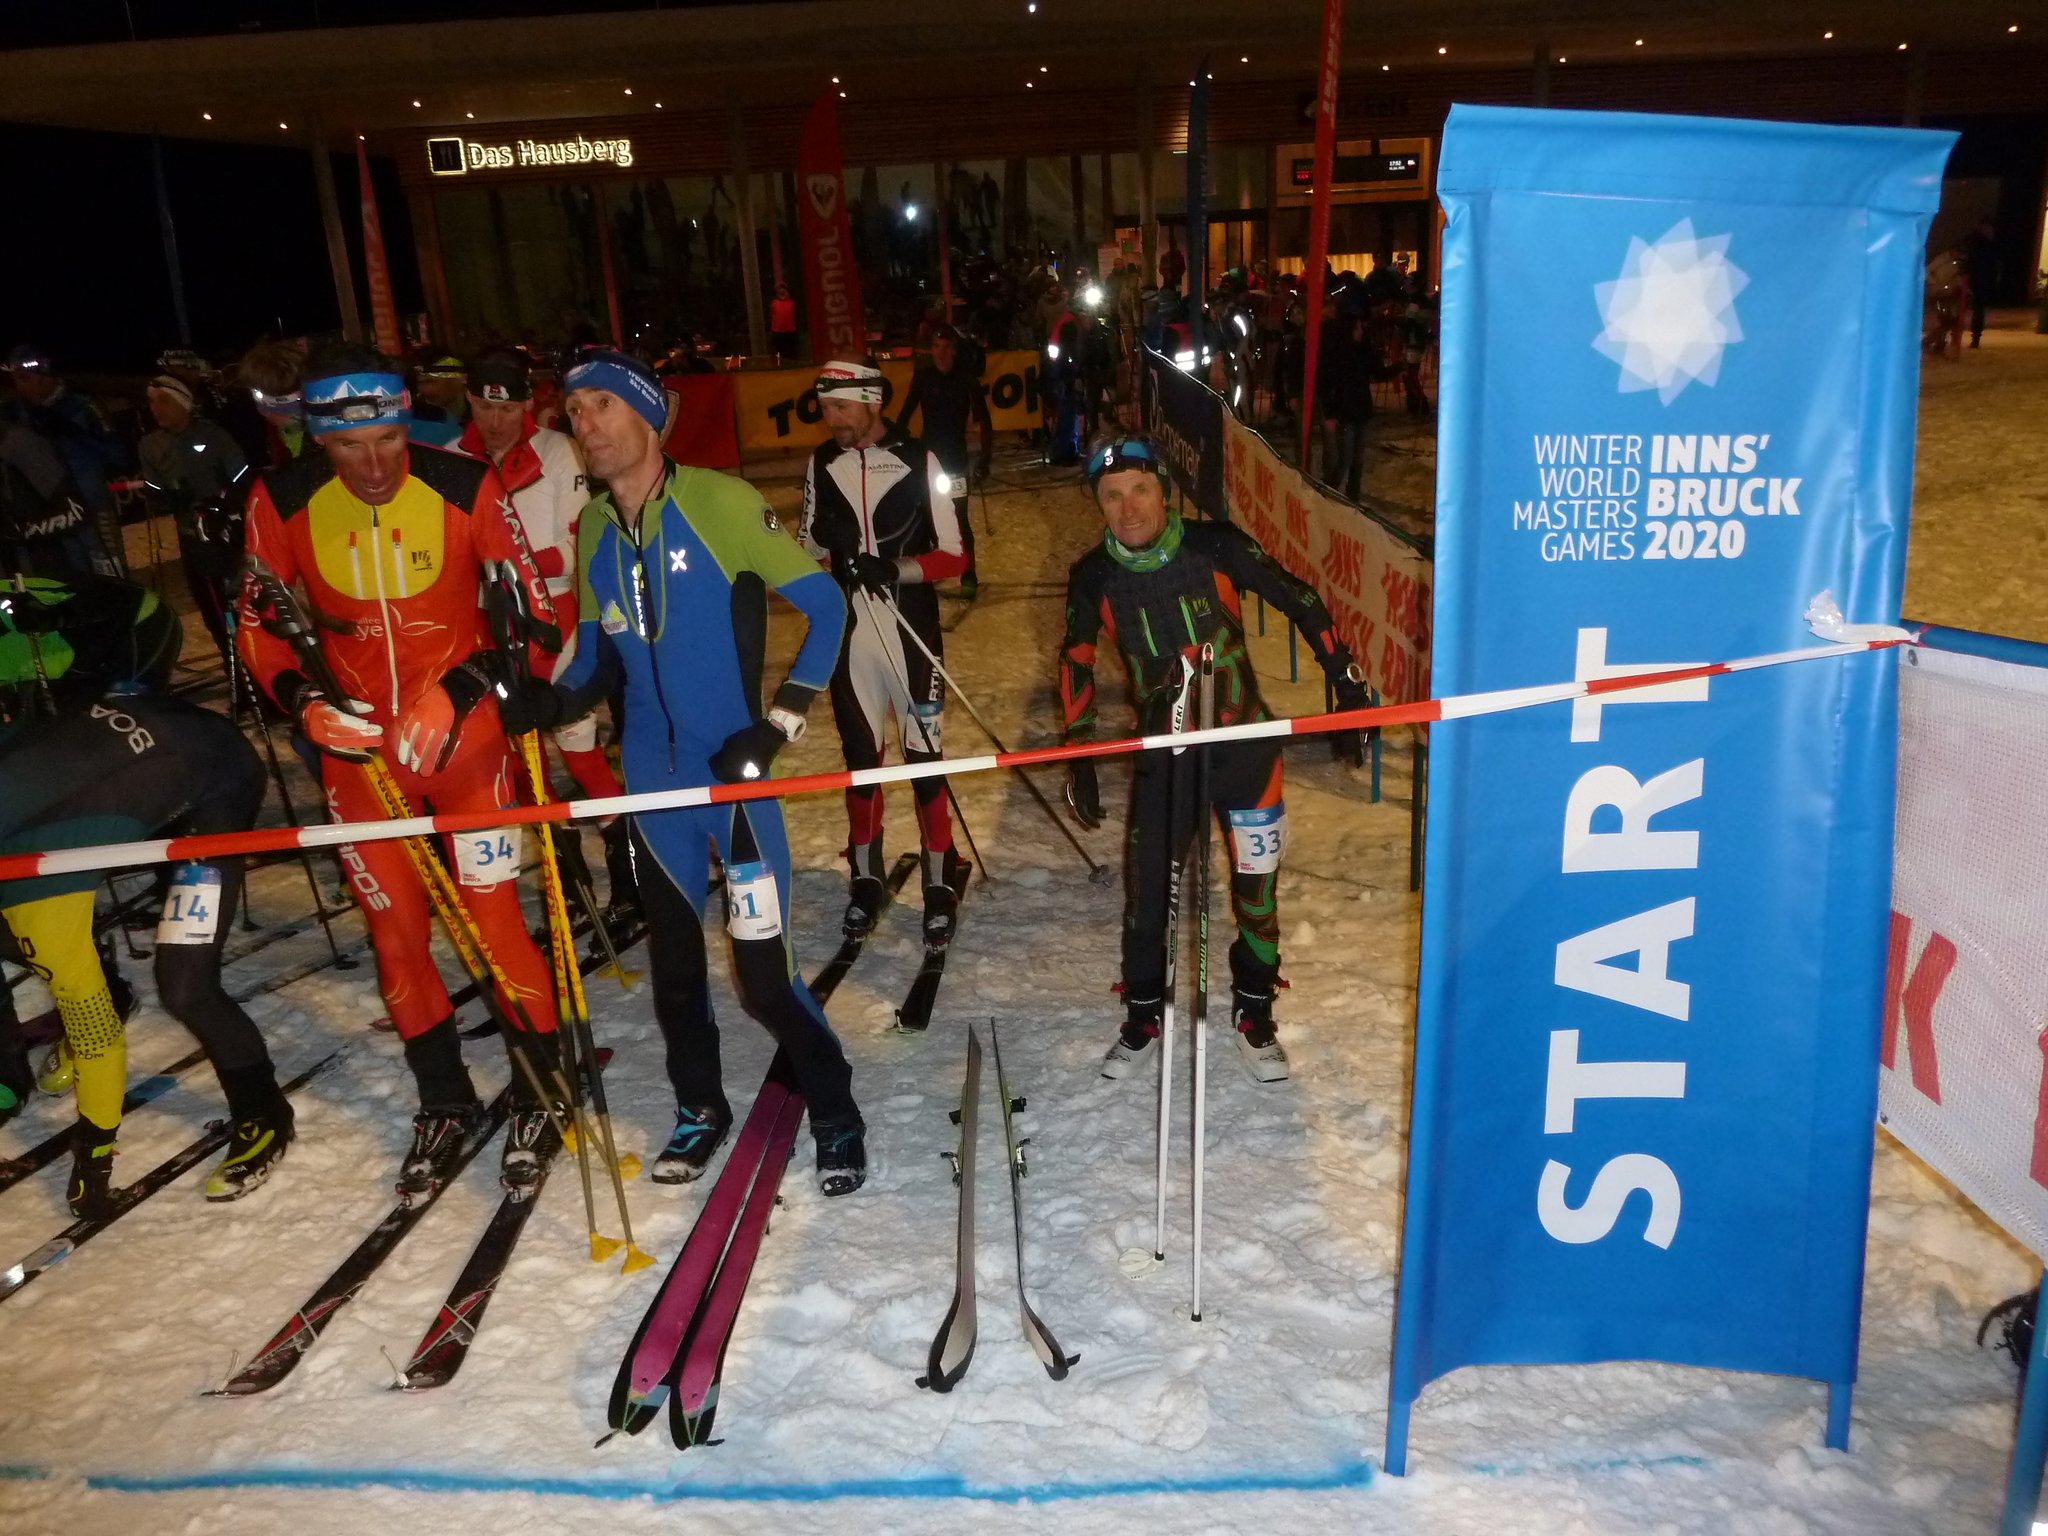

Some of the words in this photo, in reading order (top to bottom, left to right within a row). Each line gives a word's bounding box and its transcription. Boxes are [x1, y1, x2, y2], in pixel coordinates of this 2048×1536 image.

[468, 142, 513, 169] Das
[518, 133, 633, 168] Hausberg
[1534, 434, 1641, 464] WINTER
[1651, 434, 1769, 473] INNS'
[1540, 467, 1640, 497] WORLD
[1646, 478, 1801, 516] BRUCK
[1514, 501, 1637, 531] MASTERS
[1541, 532, 1635, 562] GAMES
[1642, 520, 1745, 559] 2020
[90, 704, 156, 754] BOA
[1174, 705, 1183, 731] LEKI
[325, 786, 391, 911] KAPOS
[474, 836, 514, 866] 34
[1249, 830, 1281, 857] 33
[1171, 860, 1180, 904] LEKI
[168, 895, 208, 922] 14
[730, 891, 762, 919] 61
[1537, 627, 1709, 1250] START
